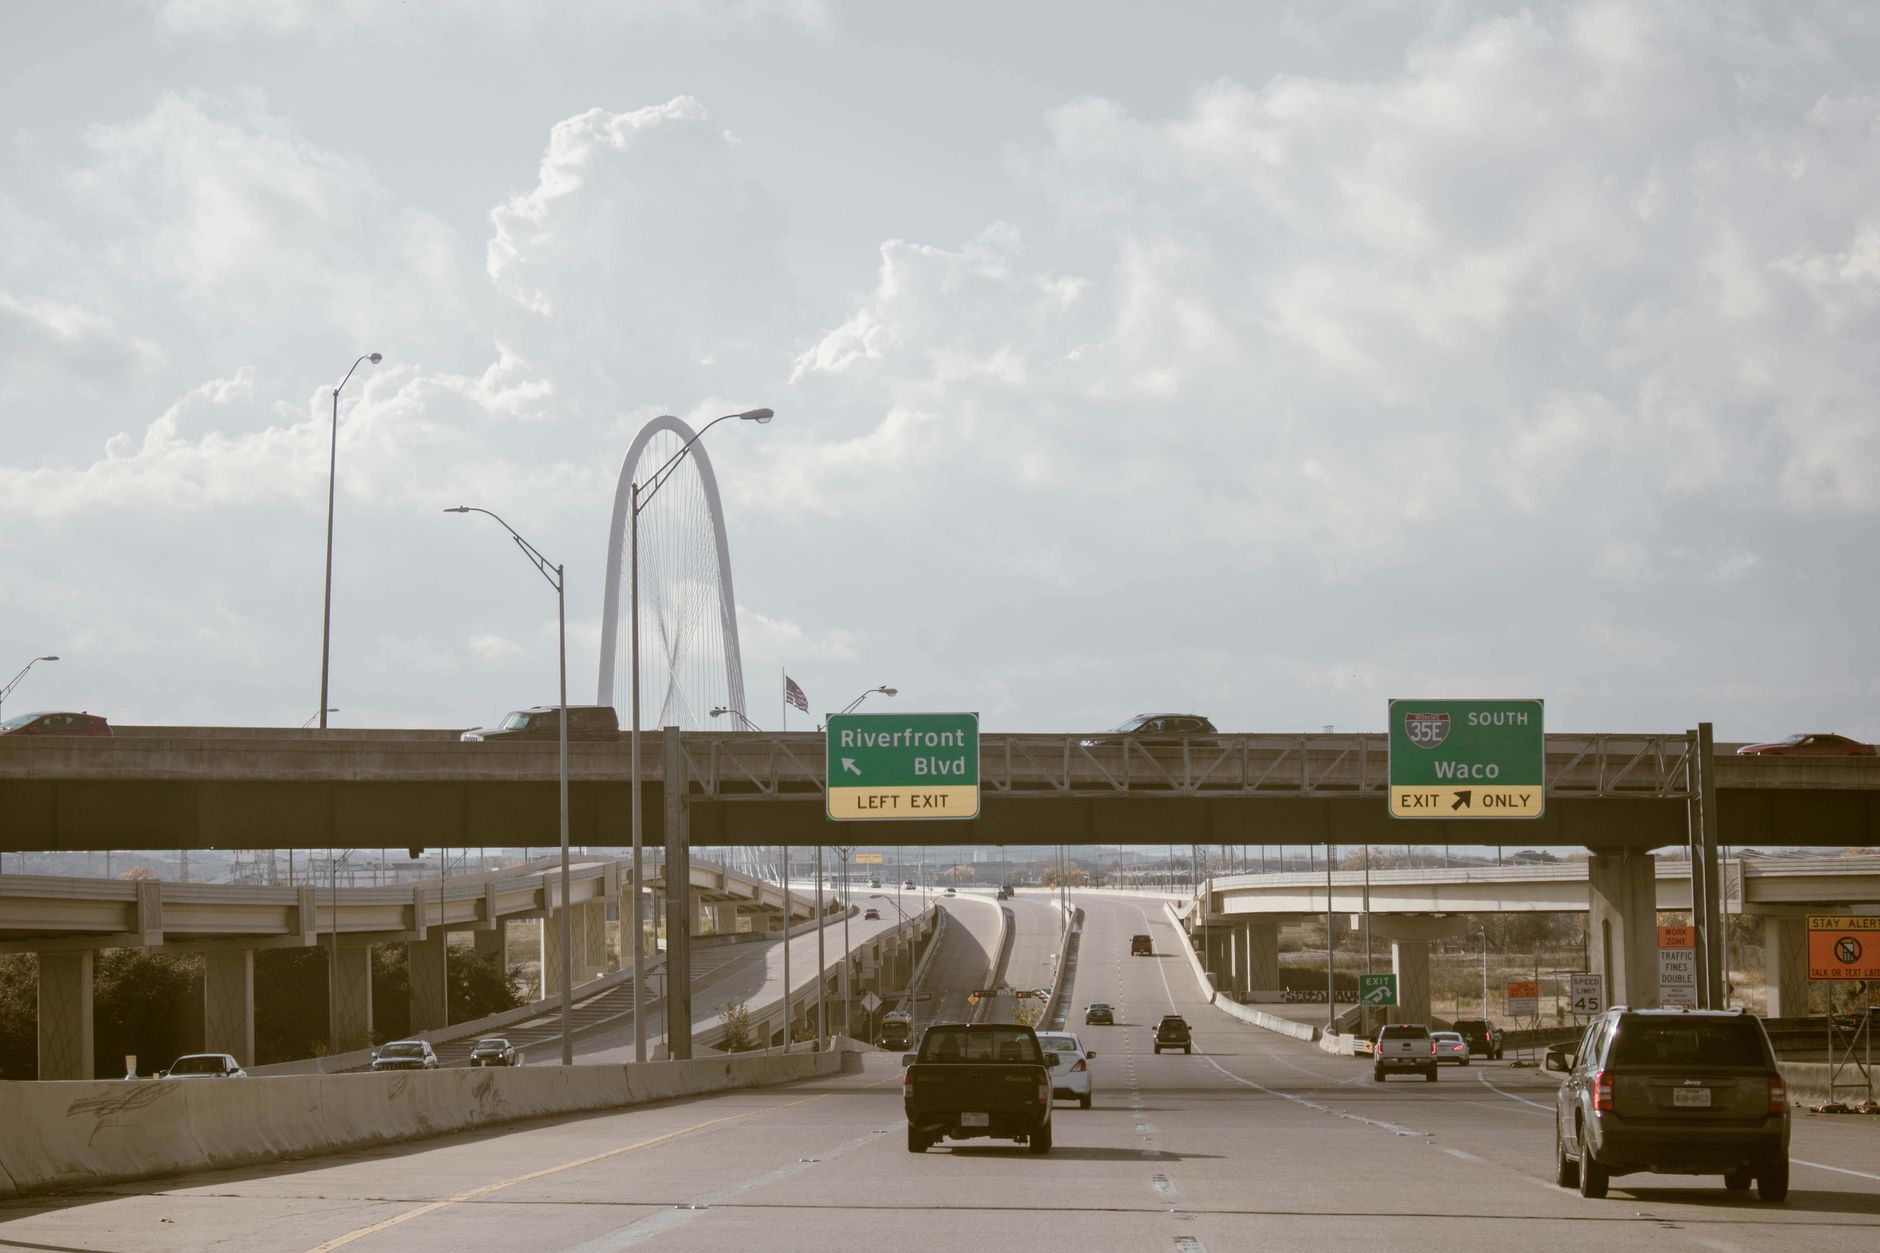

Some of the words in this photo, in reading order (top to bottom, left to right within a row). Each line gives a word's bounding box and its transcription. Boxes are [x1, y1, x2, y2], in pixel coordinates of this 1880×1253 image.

[1468, 712, 1528, 725] SOUTH
[841, 728, 965, 747] Riverfront
[1411, 722, 1442, 741] 35E
[914, 756, 966, 775] Blvd
[1434, 760, 1499, 779] Waco
[857, 795, 900, 809] LEFT
[910, 794, 949, 808] EXIT
[1401, 794, 1440, 808] EXIT
[1482, 794, 1531, 808] ONLY
[1812, 918, 1840, 928] STAY
[1665, 928, 1687, 936] WORK
[1661, 951, 1692, 960] TRAFFIC
[1665, 963, 1688, 972] FINES
[1812, 968, 1828, 977] TALK
[1831, 968, 1841, 977] OR
[1845, 968, 1861, 977] TEXT
[1366, 977, 1389, 986] EXIT
[1662, 974, 1692, 983] DOUBLE
[1575, 997, 1599, 1010] 45
